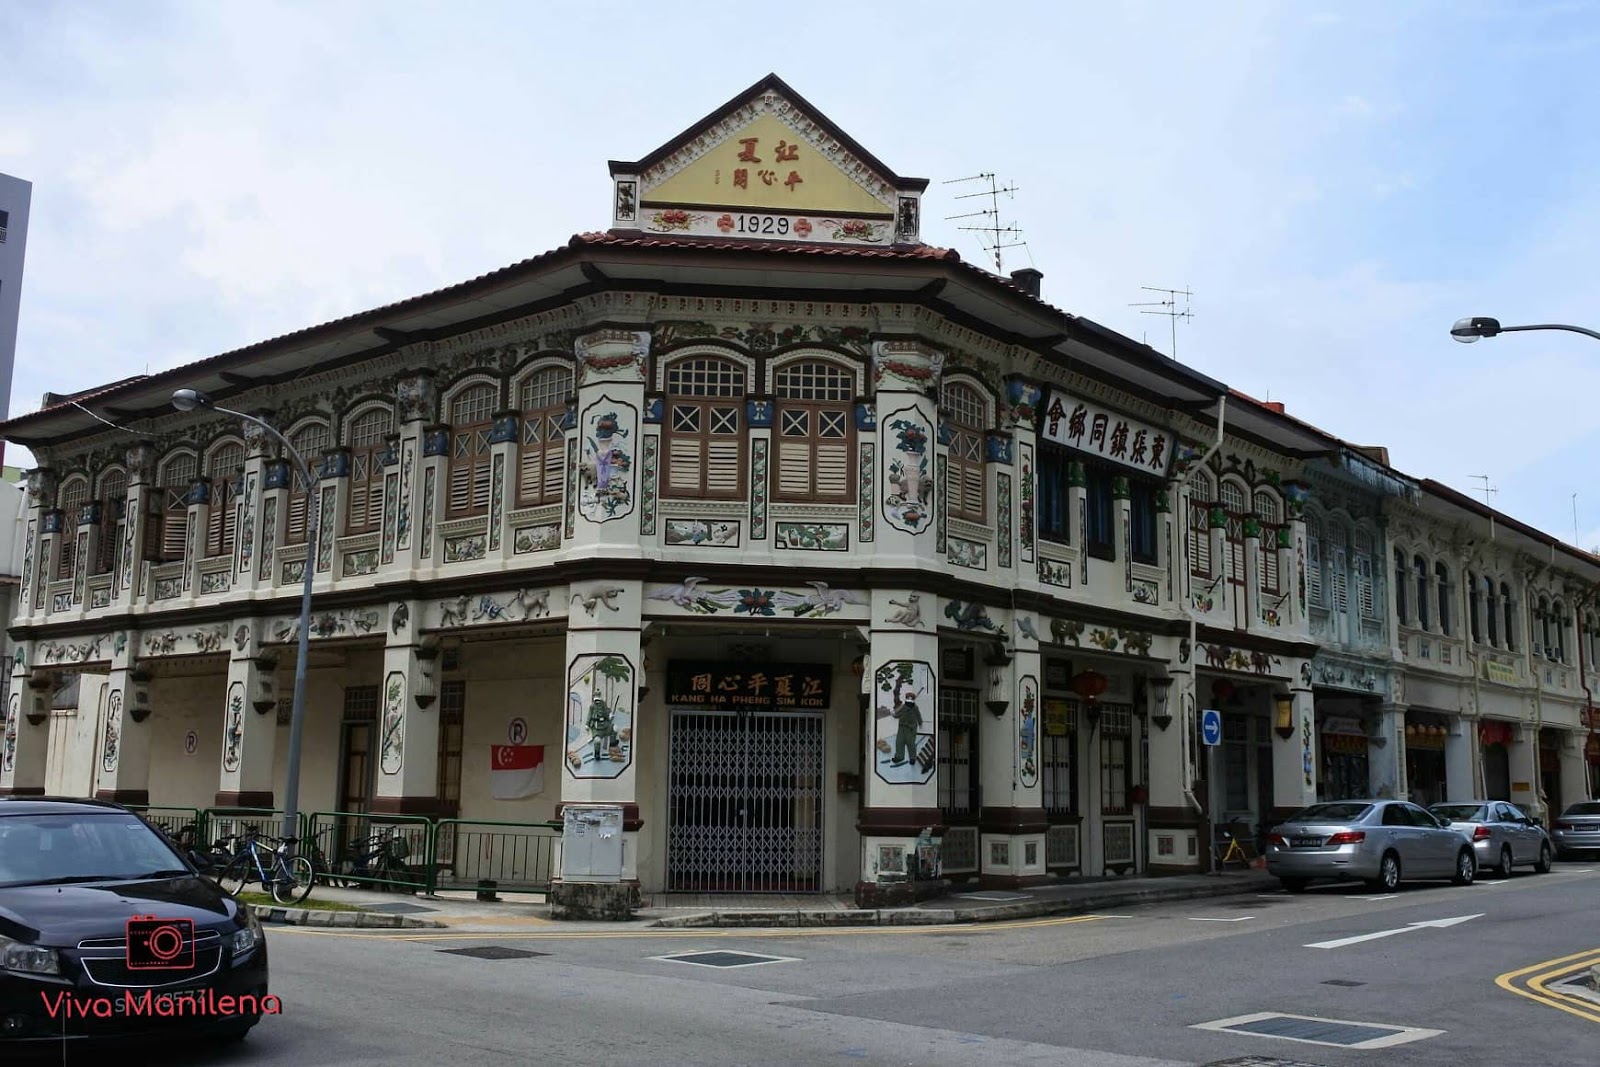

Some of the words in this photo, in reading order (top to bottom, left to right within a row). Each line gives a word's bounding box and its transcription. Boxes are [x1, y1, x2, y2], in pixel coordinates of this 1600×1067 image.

[738, 214, 789, 235] 1929
[671, 694, 704, 703] KANG
[711, 695, 726, 704] HA
[732, 695, 770, 705] PHENG
[776, 697, 795, 706] SIM
[801, 698, 823, 706] KOK
